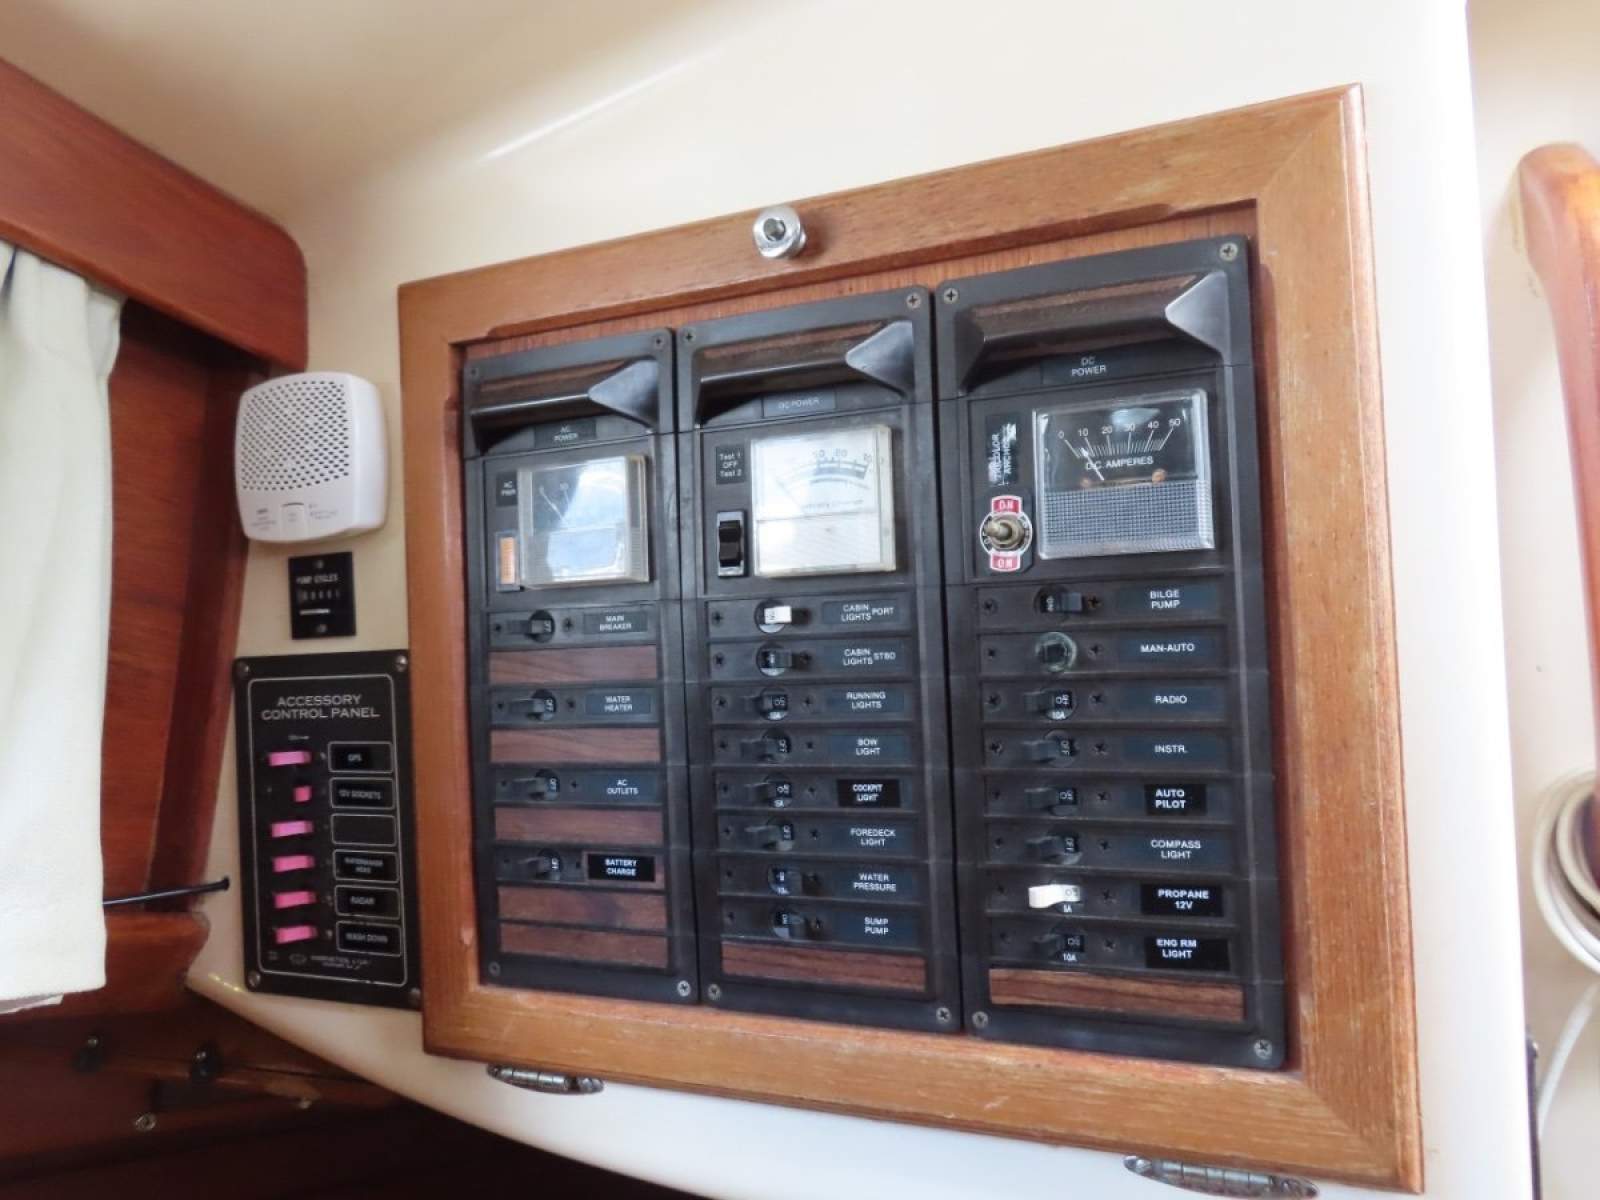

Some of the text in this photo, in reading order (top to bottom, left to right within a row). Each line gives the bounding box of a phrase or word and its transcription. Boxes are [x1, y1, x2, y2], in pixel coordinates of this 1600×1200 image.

[1081, 357, 1095, 366] DC
[1071, 365, 1106, 377] POWER
[1148, 420, 1159, 429] 40
[1078, 428, 1089, 437] 10
[1101, 425, 1112, 435] 20
[554, 432, 578, 441] POWER
[1057, 431, 1065, 439] 0
[720, 453, 735, 461] Test
[722, 461, 738, 470] OFF
[1106, 456, 1154, 468] AMPERES
[720, 469, 742, 478] Test 2
[1150, 590, 1180, 599] BILGE
[843, 604, 869, 612] CABIN
[1151, 600, 1180, 609] PUMP
[841, 613, 872, 621] LIGHTS
[600, 623, 632, 631] BREAKER
[1140, 643, 1195, 652] MAN-AUTO
[844, 649, 871, 657] CABIN
[874, 652, 896, 660] STBD
[843, 658, 873, 666] LIGHTS
[605, 695, 631, 703] WATER
[846, 691, 886, 700] RUNNING
[1155, 695, 1187, 704] RADIO
[277, 694, 362, 707] ACCESSORY
[851, 700, 882, 709] LIGHTS
[604, 703, 633, 712] HEATER
[261, 707, 380, 720] CONTROL PANEL
[855, 747, 881, 756] LIGHT
[1154, 745, 1187, 753] INSTR.
[606, 787, 639, 795] OUTLETS
[852, 784, 883, 792] COCKPIT
[856, 793, 879, 801] LIGHT
[1155, 789, 1185, 798] AUTO
[1155, 799, 1186, 808] PILOT
[850, 828, 896, 836] FOREDECK
[860, 837, 886, 846] LIGHT
[1150, 839, 1201, 849] COMPASS
[1160, 850, 1192, 859] LIGHT
[605, 858, 637, 866] BATTERY
[606, 867, 636, 876] CHARGE
[859, 873, 889, 881] WATER
[853, 882, 897, 892] PRESSURE
[1157, 889, 1209, 899] PROPANE
[1174, 900, 1193, 909] 12V
[864, 917, 888, 925] SUMP
[864, 926, 889, 935] PUMP
[1156, 939, 1197, 948] ENG RM
[1162, 949, 1193, 958] LIGHT
